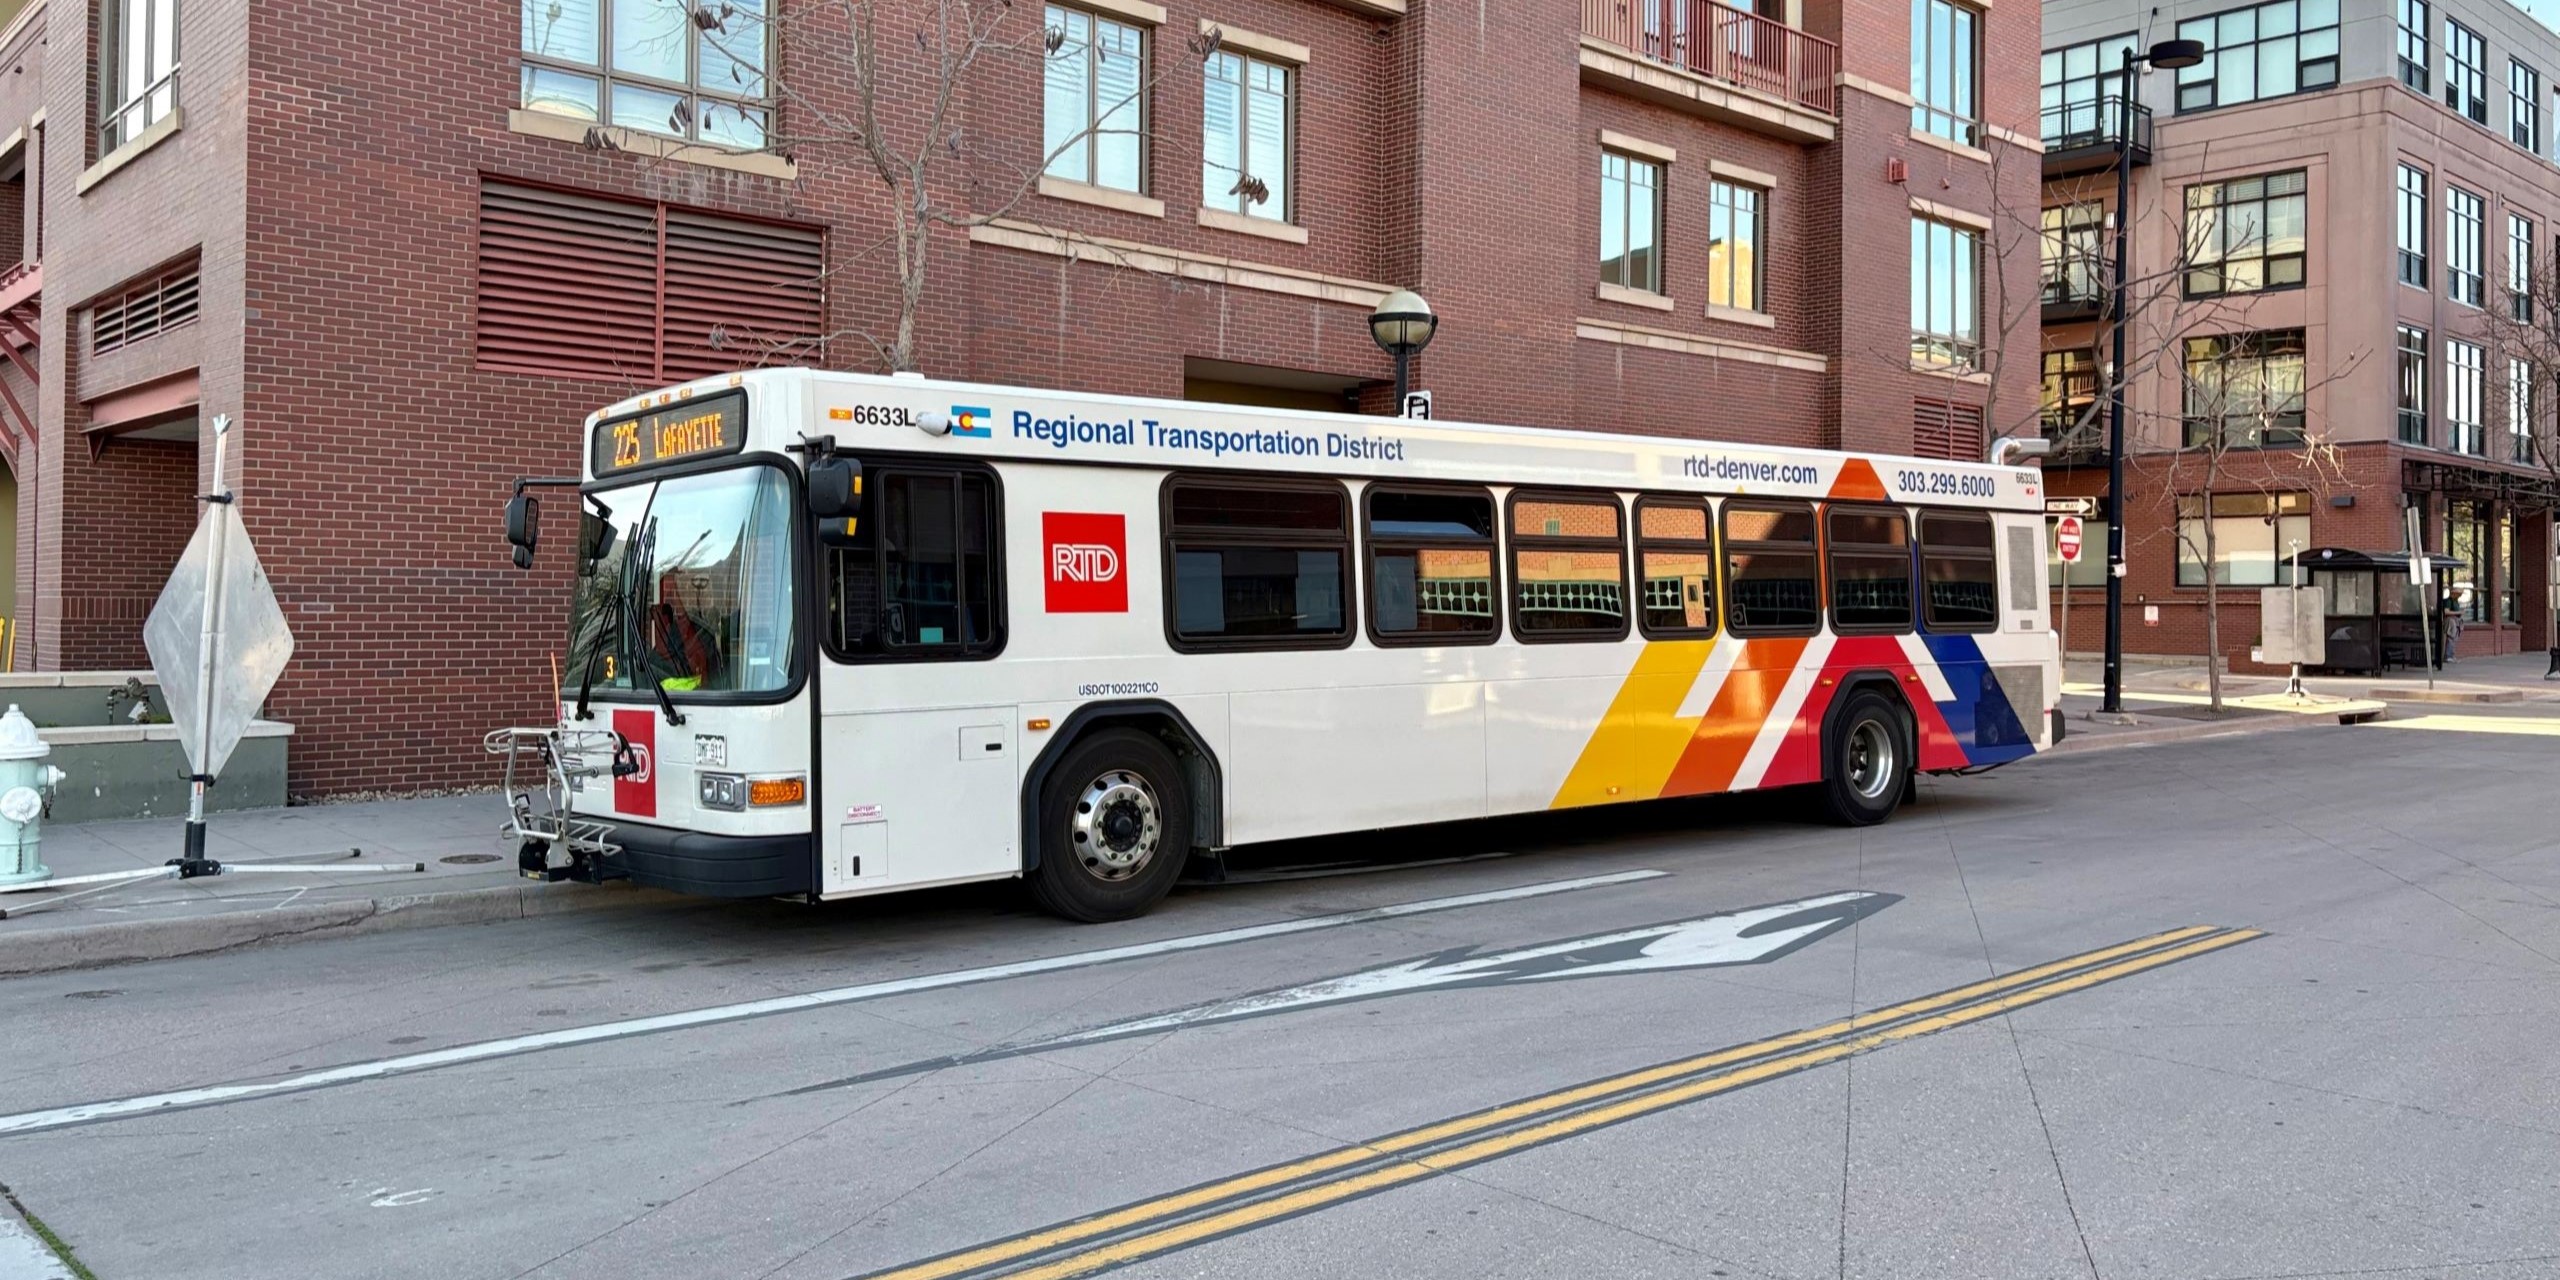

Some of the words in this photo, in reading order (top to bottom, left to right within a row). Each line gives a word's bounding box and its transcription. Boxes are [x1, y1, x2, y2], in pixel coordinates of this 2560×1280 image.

[854, 405, 917, 427] 6633L
[613, 419, 640, 467] 225
[1013, 411, 1134, 448] Regional
[1142, 420, 1319, 457] Transportation
[1327, 433, 1404, 461] District
[1684, 454, 1818, 484] rtd-denver.com
[2016, 472, 2038, 484] 6633L
[1898, 470, 1995, 497] 303.299.6000
[1052, 543, 1118, 582] RTD
[606, 655, 614, 679] 3
[1079, 682, 1159, 696] USDOT1002211CO
